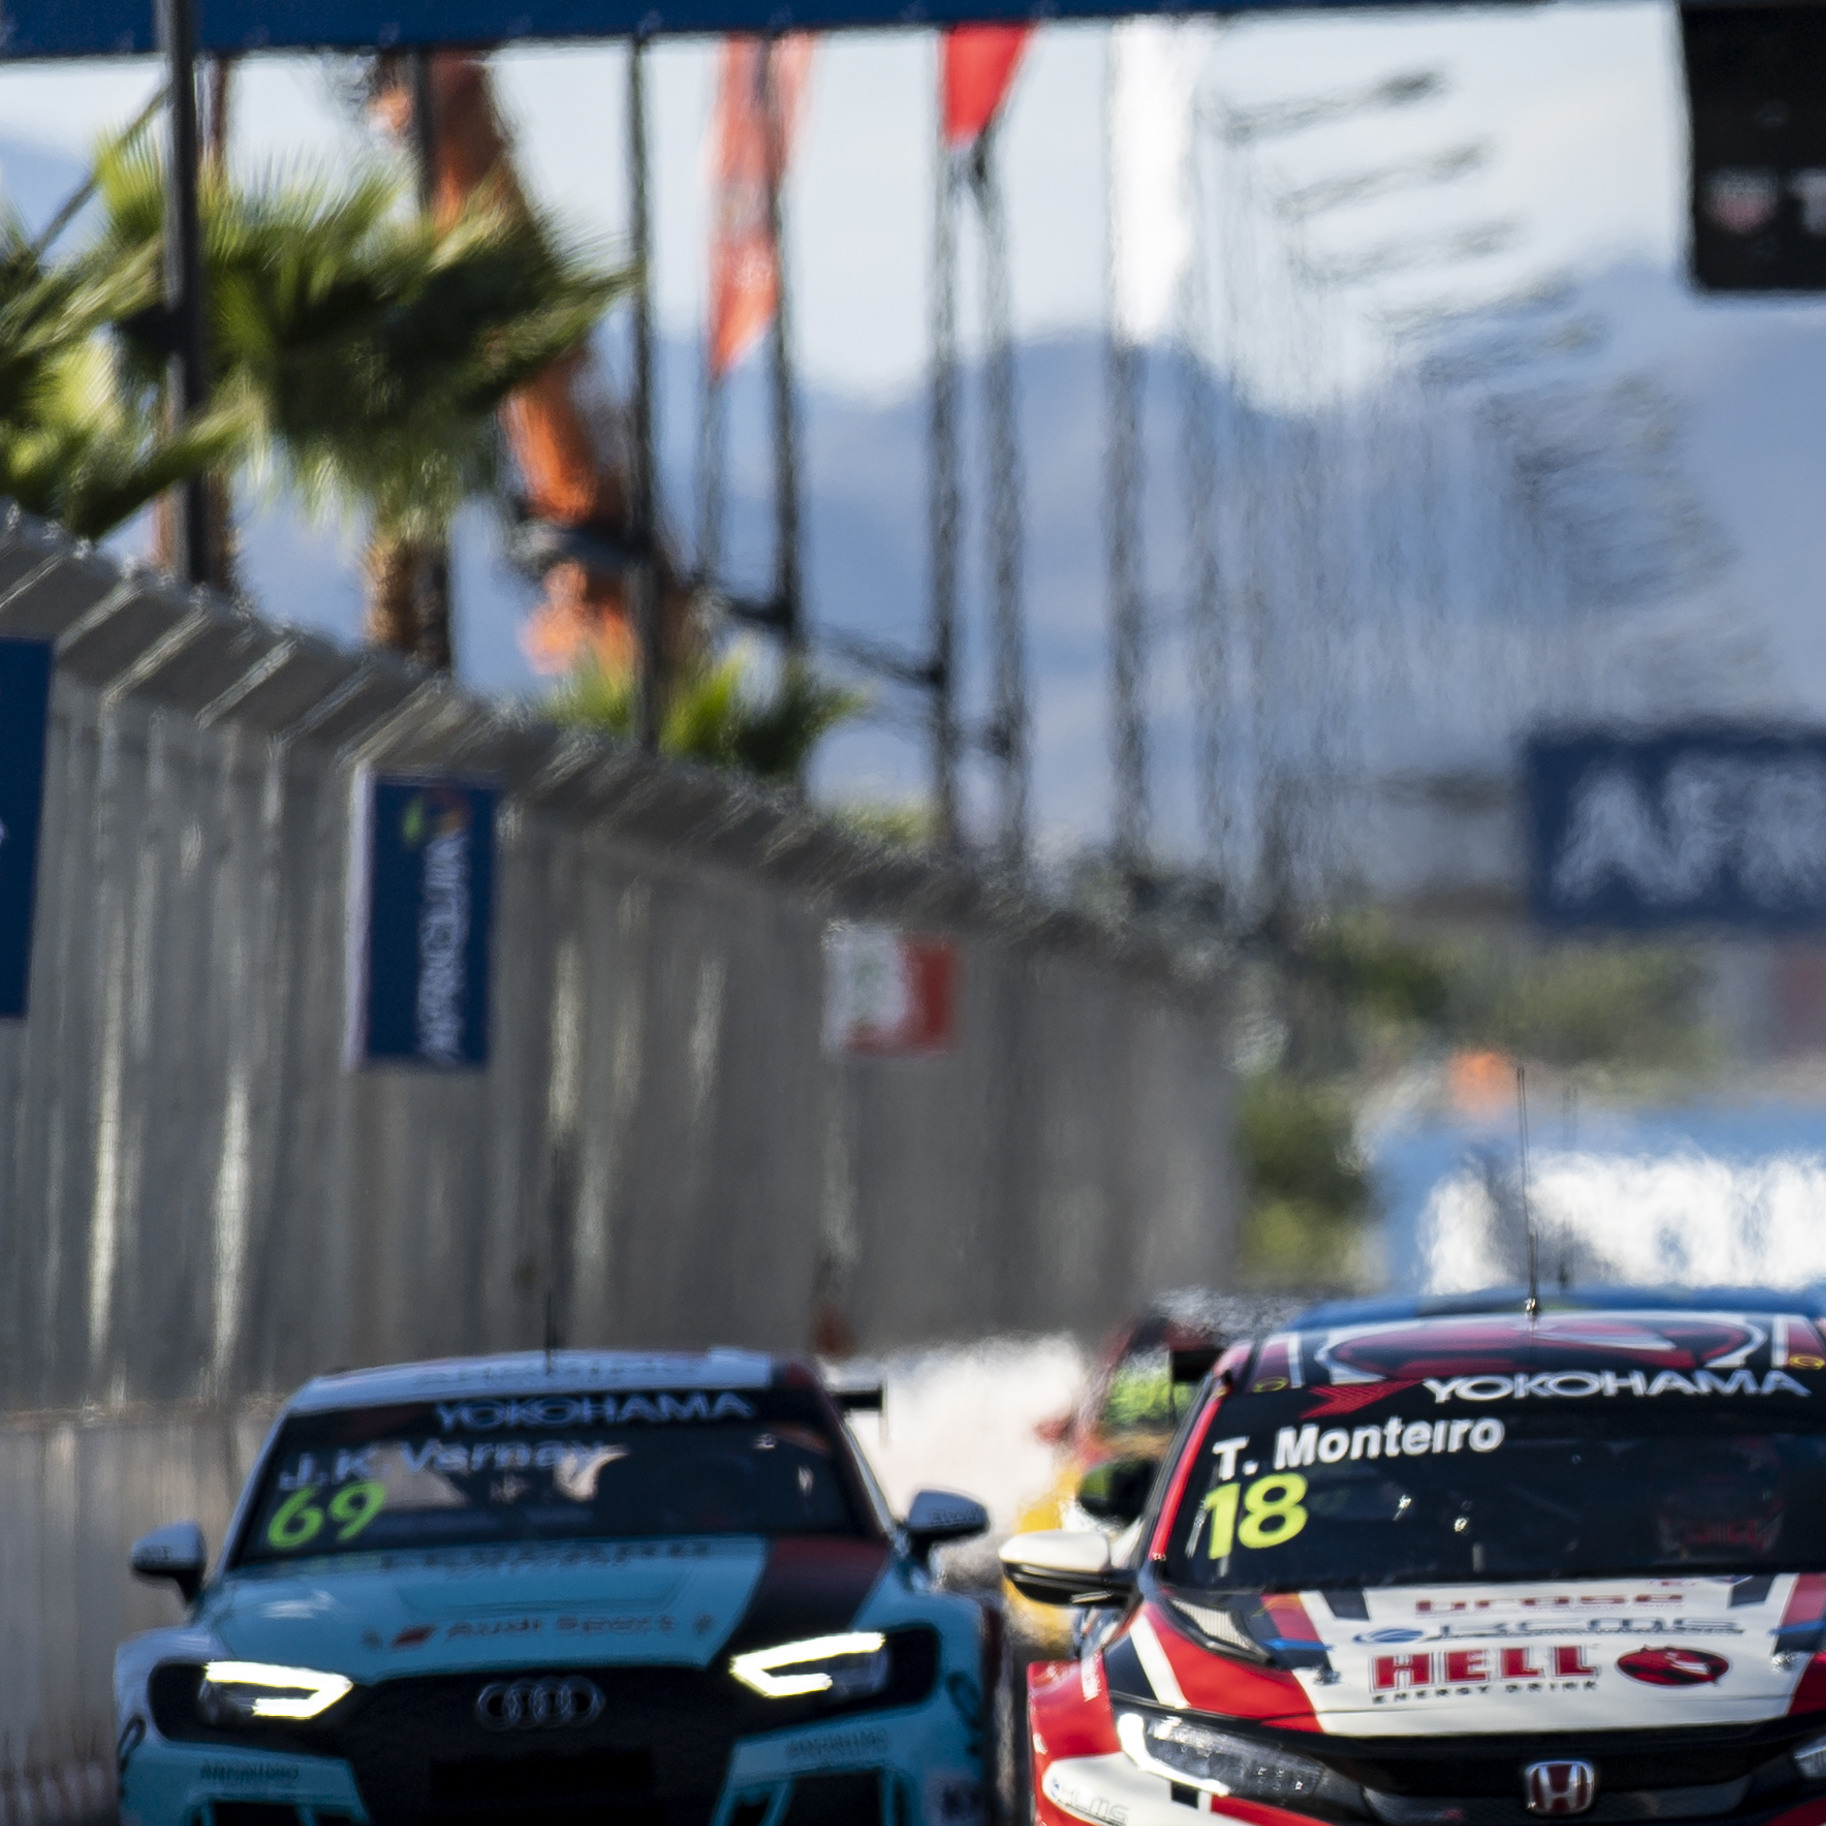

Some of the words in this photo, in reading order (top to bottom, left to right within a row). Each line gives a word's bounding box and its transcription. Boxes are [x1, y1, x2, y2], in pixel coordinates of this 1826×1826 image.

[1422, 1369, 1812, 1403] YOKOHAMA
[433, 1391, 756, 1432] YOKOHAMA
[1212, 1436, 1259, 1481] T.
[1272, 1416, 1505, 1471] Monteiro
[267, 1480, 387, 1549] 69
[1204, 1472, 1309, 1560] 18
[1370, 1645, 1599, 1693] HELL
[1372, 1685, 1489, 1705] ENERGY
[1505, 1680, 1599, 1694] DRINK
